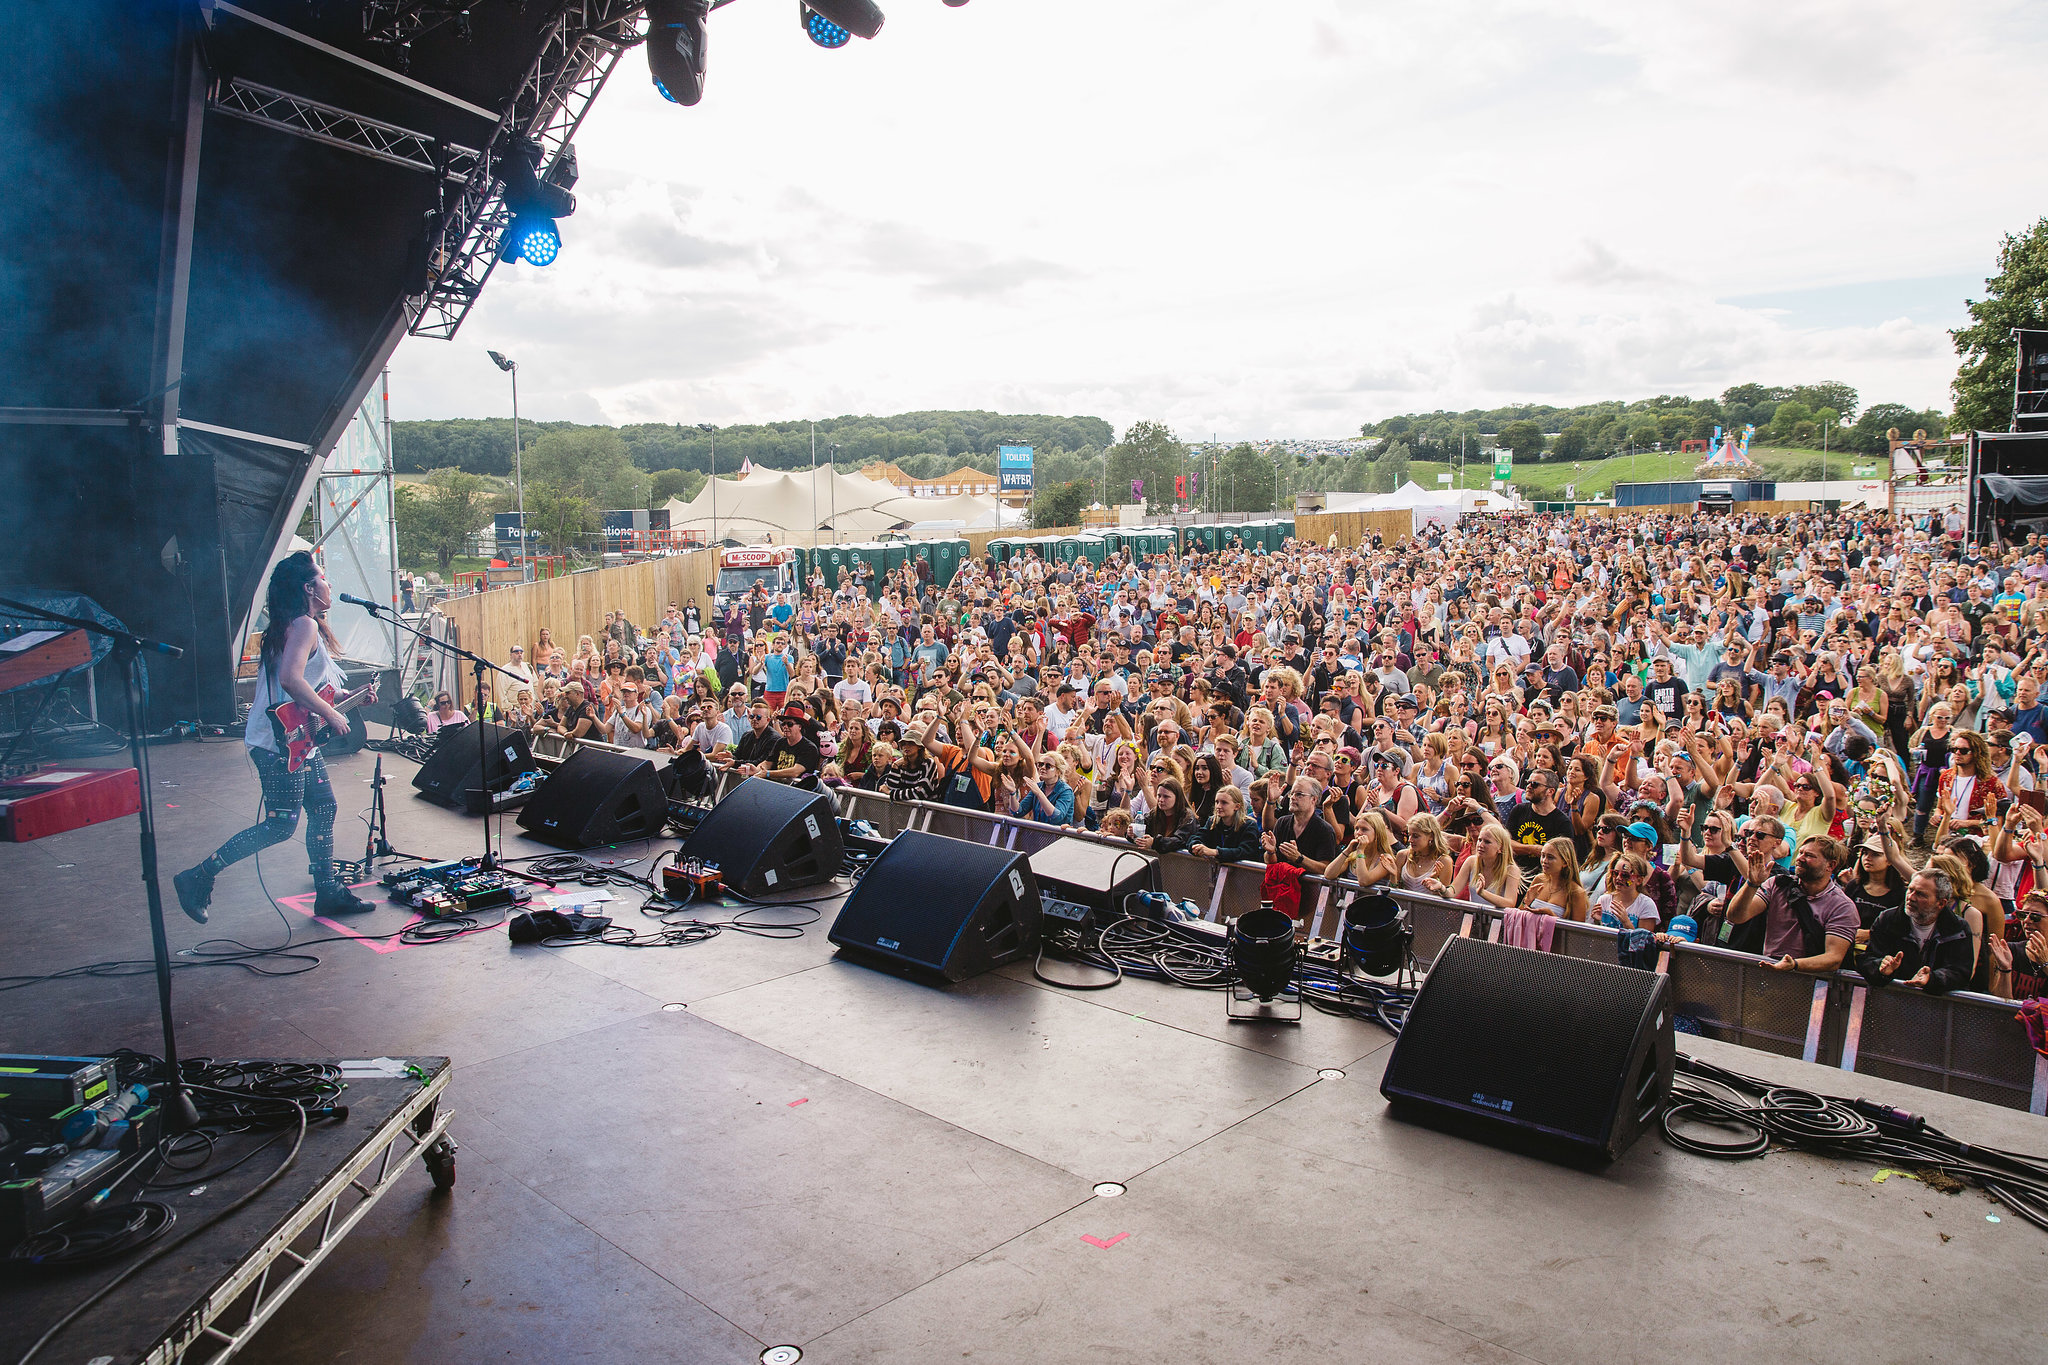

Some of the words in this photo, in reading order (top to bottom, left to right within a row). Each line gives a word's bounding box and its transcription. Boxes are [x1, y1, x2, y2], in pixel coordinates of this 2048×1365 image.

[1005, 453, 1030, 461] TOILETS
[1002, 473, 1032, 486] WATER
[1654, 687, 1675, 696] EARTH
[1517, 821, 1544, 838] MIDNIGHT
[1012, 877, 1022, 891] 2
